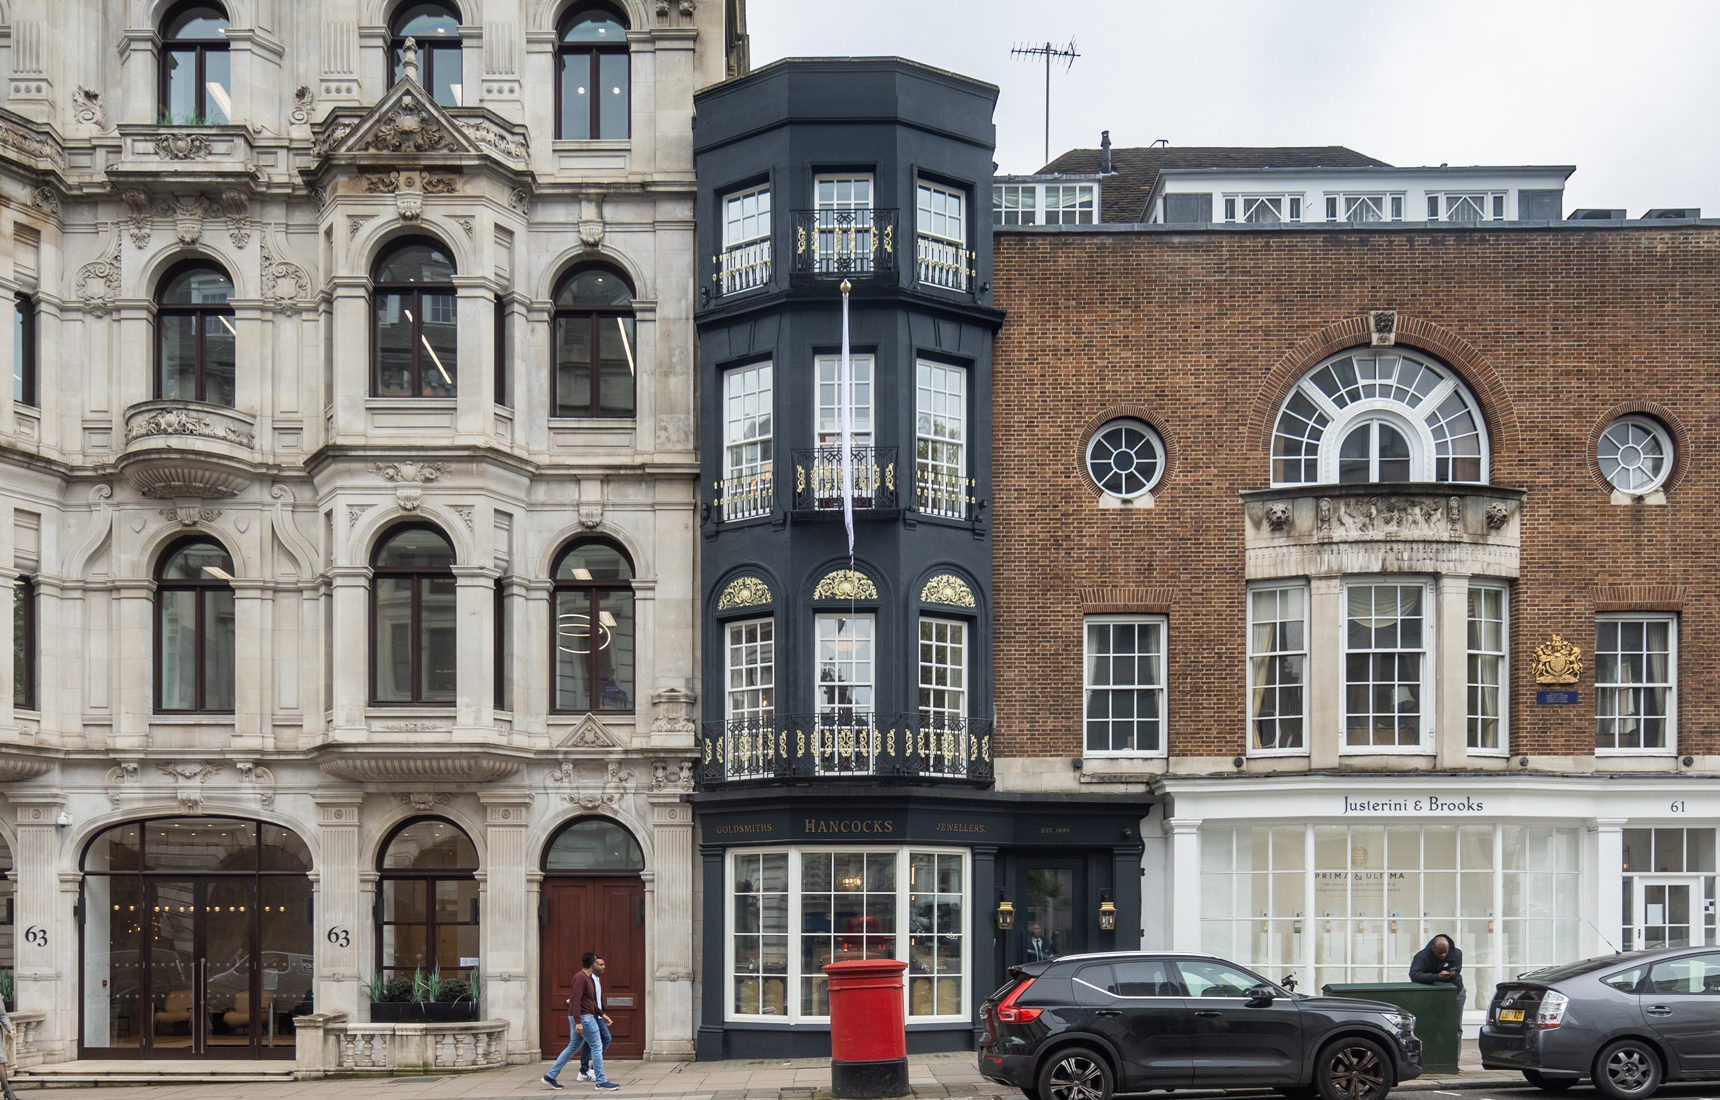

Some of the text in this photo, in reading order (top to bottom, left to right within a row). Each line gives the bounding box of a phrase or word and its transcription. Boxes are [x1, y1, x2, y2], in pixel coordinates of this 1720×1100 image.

[1343, 796, 1484, 814] Justerini & Brooks
[1670, 800, 1686, 813] 61
[804, 819, 893, 833] HANCOCKS
[24, 925, 49, 948] 63
[326, 925, 351, 948] 63
